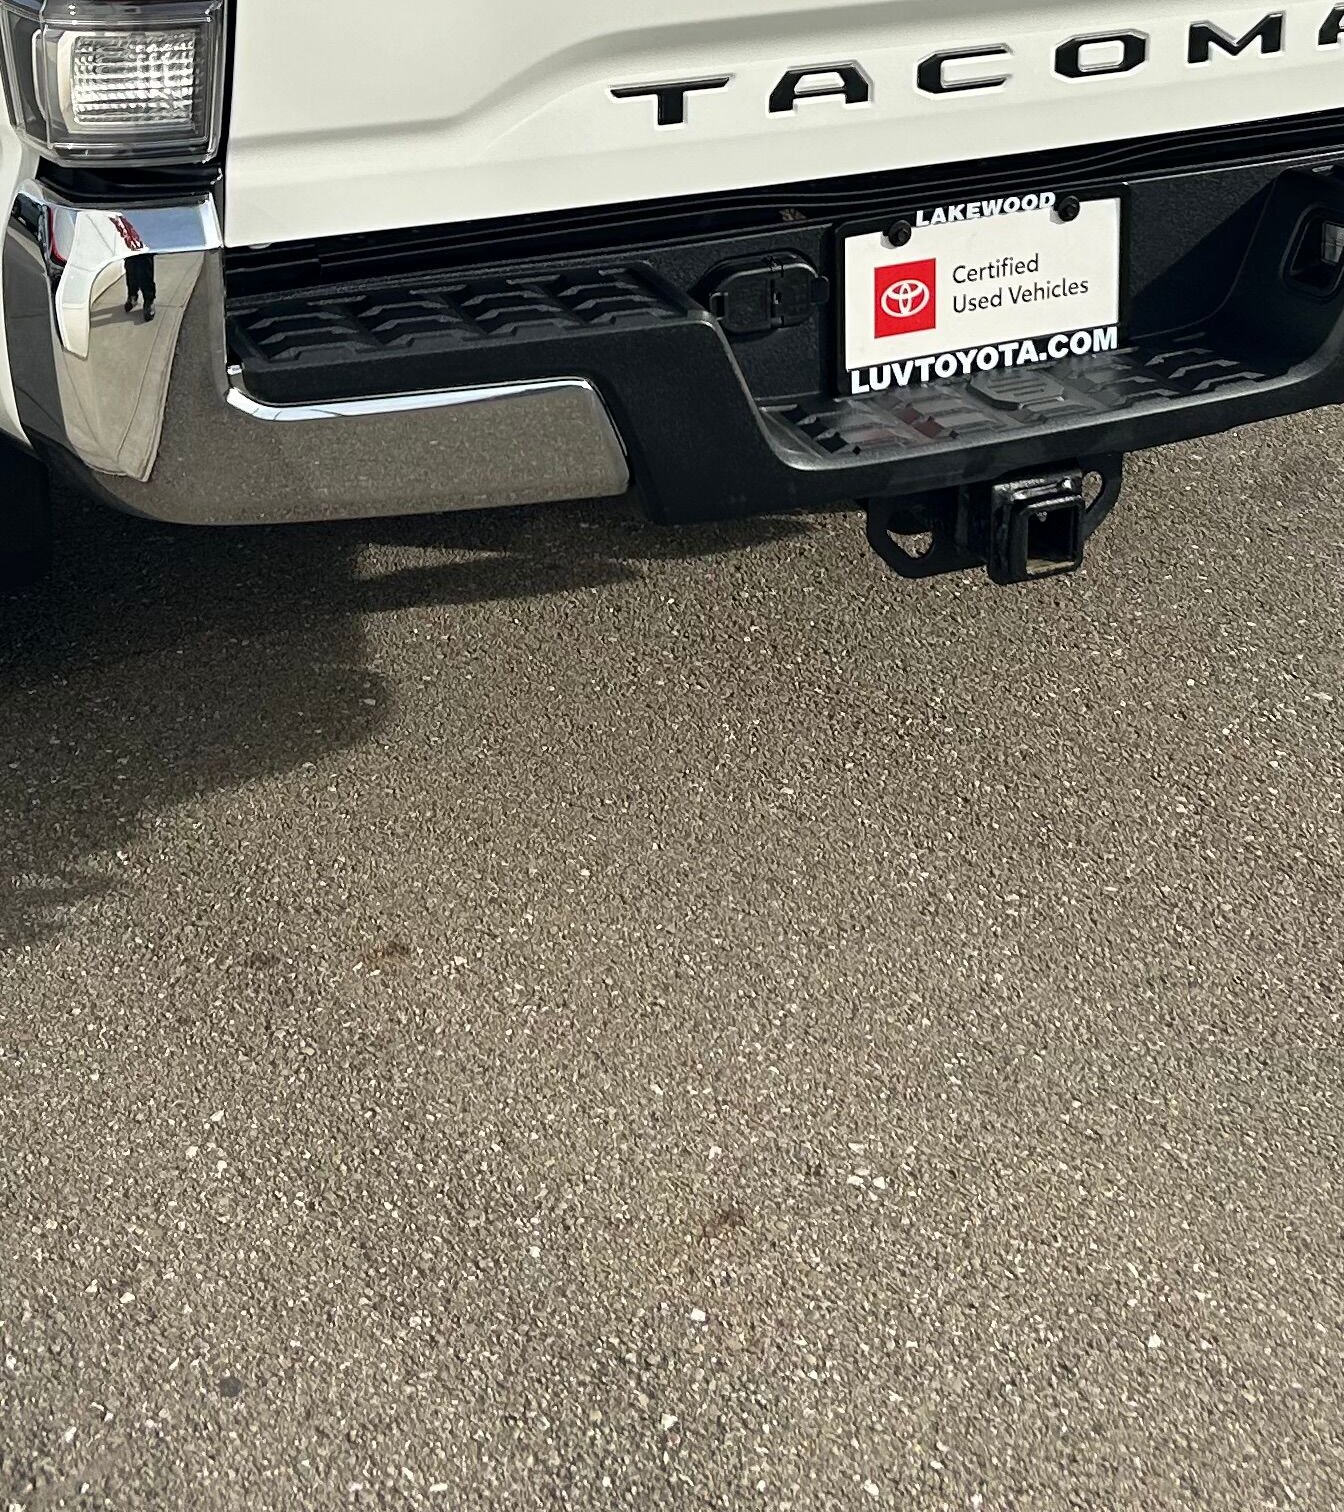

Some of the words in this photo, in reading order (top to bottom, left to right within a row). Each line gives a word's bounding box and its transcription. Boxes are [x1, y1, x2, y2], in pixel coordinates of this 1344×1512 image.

[915, 191, 1057, 228] LAKEWOOD
[952, 253, 1040, 284] Certified
[952, 288, 1003, 314] Used
[1009, 277, 1090, 305] Vehicles
[850, 326, 1119, 395] LUVTOYOTA.COM
